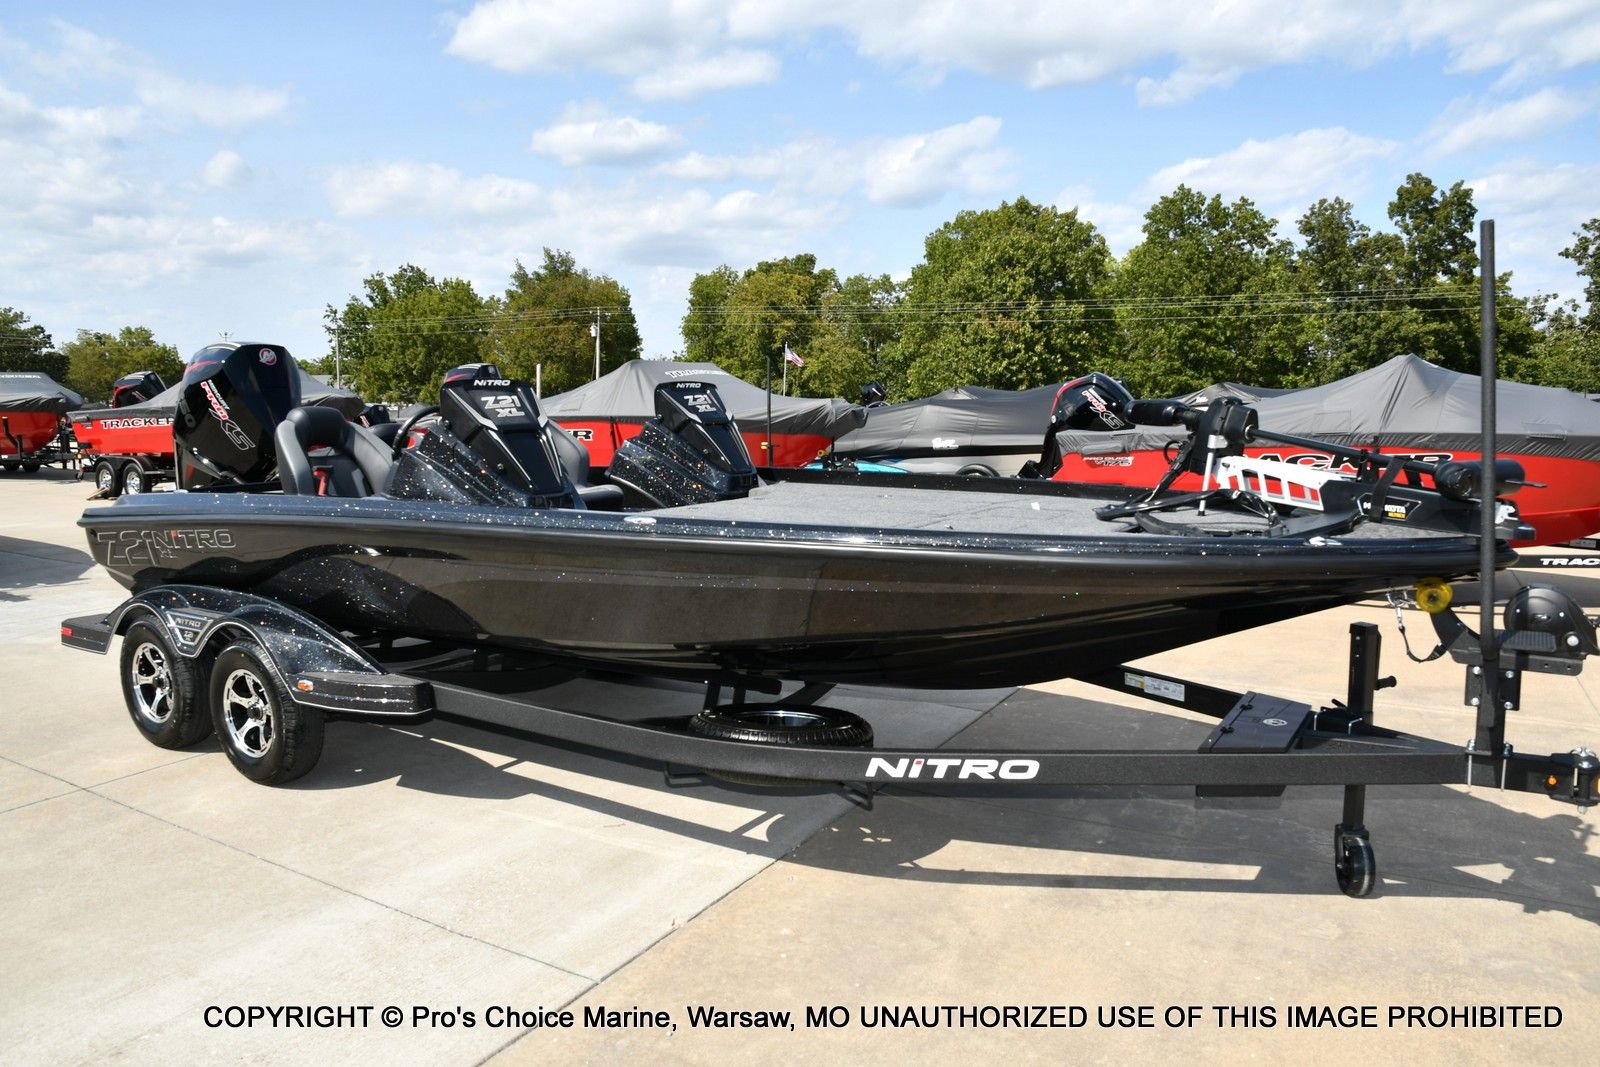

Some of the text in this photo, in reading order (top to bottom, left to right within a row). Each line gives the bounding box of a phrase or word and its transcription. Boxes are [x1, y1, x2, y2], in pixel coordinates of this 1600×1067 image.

[481, 395, 522, 410] Z21
[683, 394, 712, 406] Z21
[495, 407, 526, 418] XL
[695, 404, 717, 413] XL
[1089, 406, 1125, 430] XS
[208, 407, 256, 451] XS
